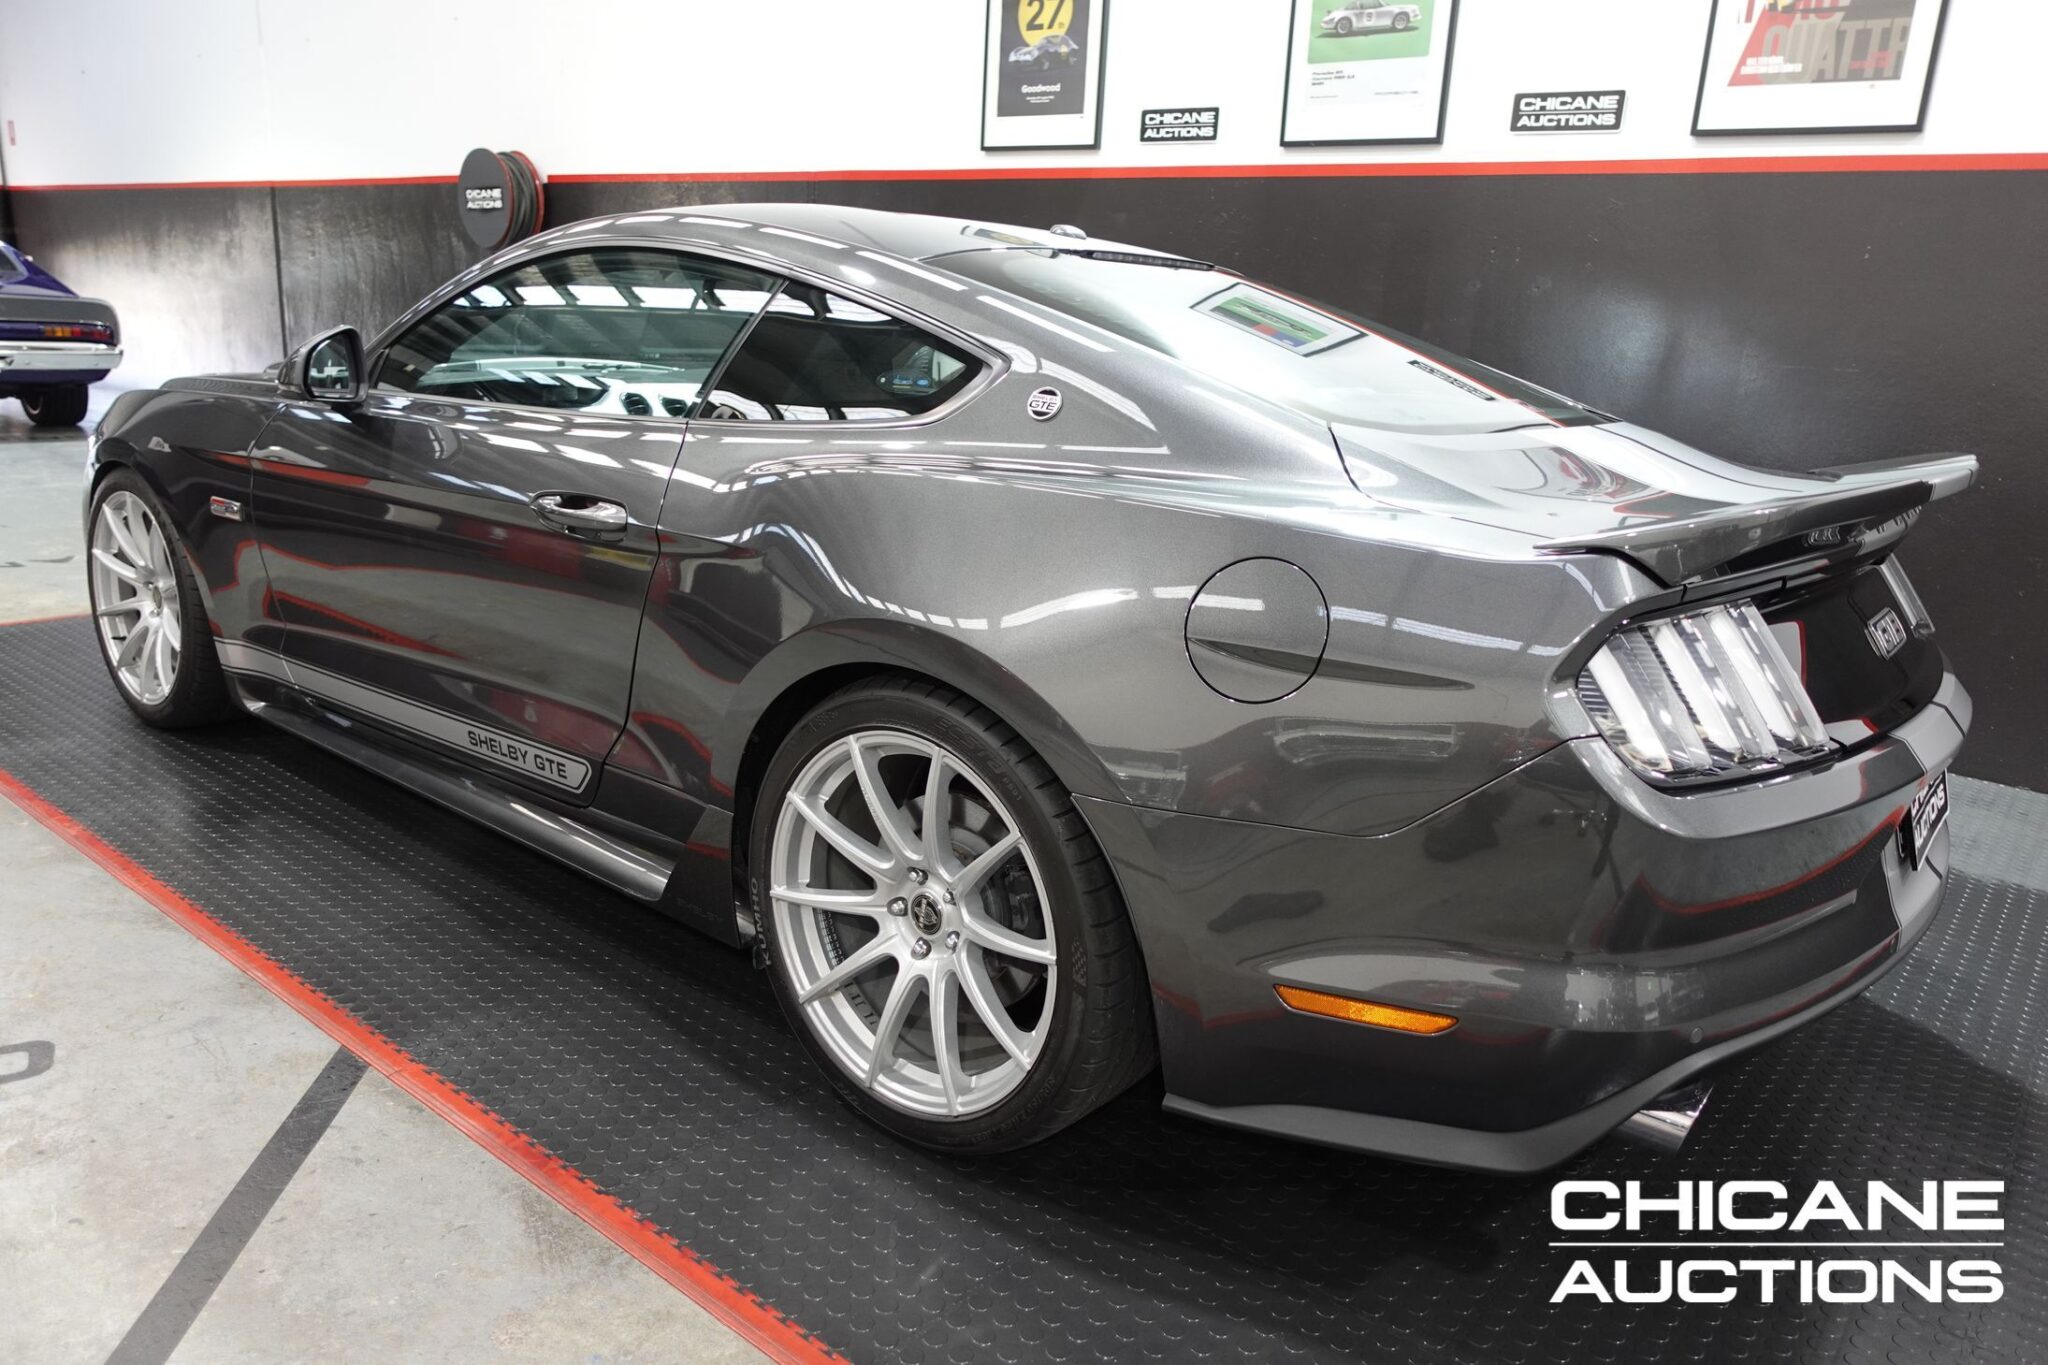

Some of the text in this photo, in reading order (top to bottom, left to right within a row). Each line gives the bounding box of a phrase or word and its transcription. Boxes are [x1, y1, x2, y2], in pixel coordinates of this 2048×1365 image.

[1026, 0, 1066, 31] 27
[1021, 82, 1061, 94] Goodwood
[1519, 95, 1619, 112] CHICANE
[1144, 112, 1216, 125] CHICANE
[1517, 112, 1616, 127] AUCTIONS
[1143, 126, 1215, 138] AUCTIONS
[1029, 400, 1057, 411] GTE
[467, 730, 568, 780] SHELBY GTE
[751, 877, 771, 966] KUMHO
